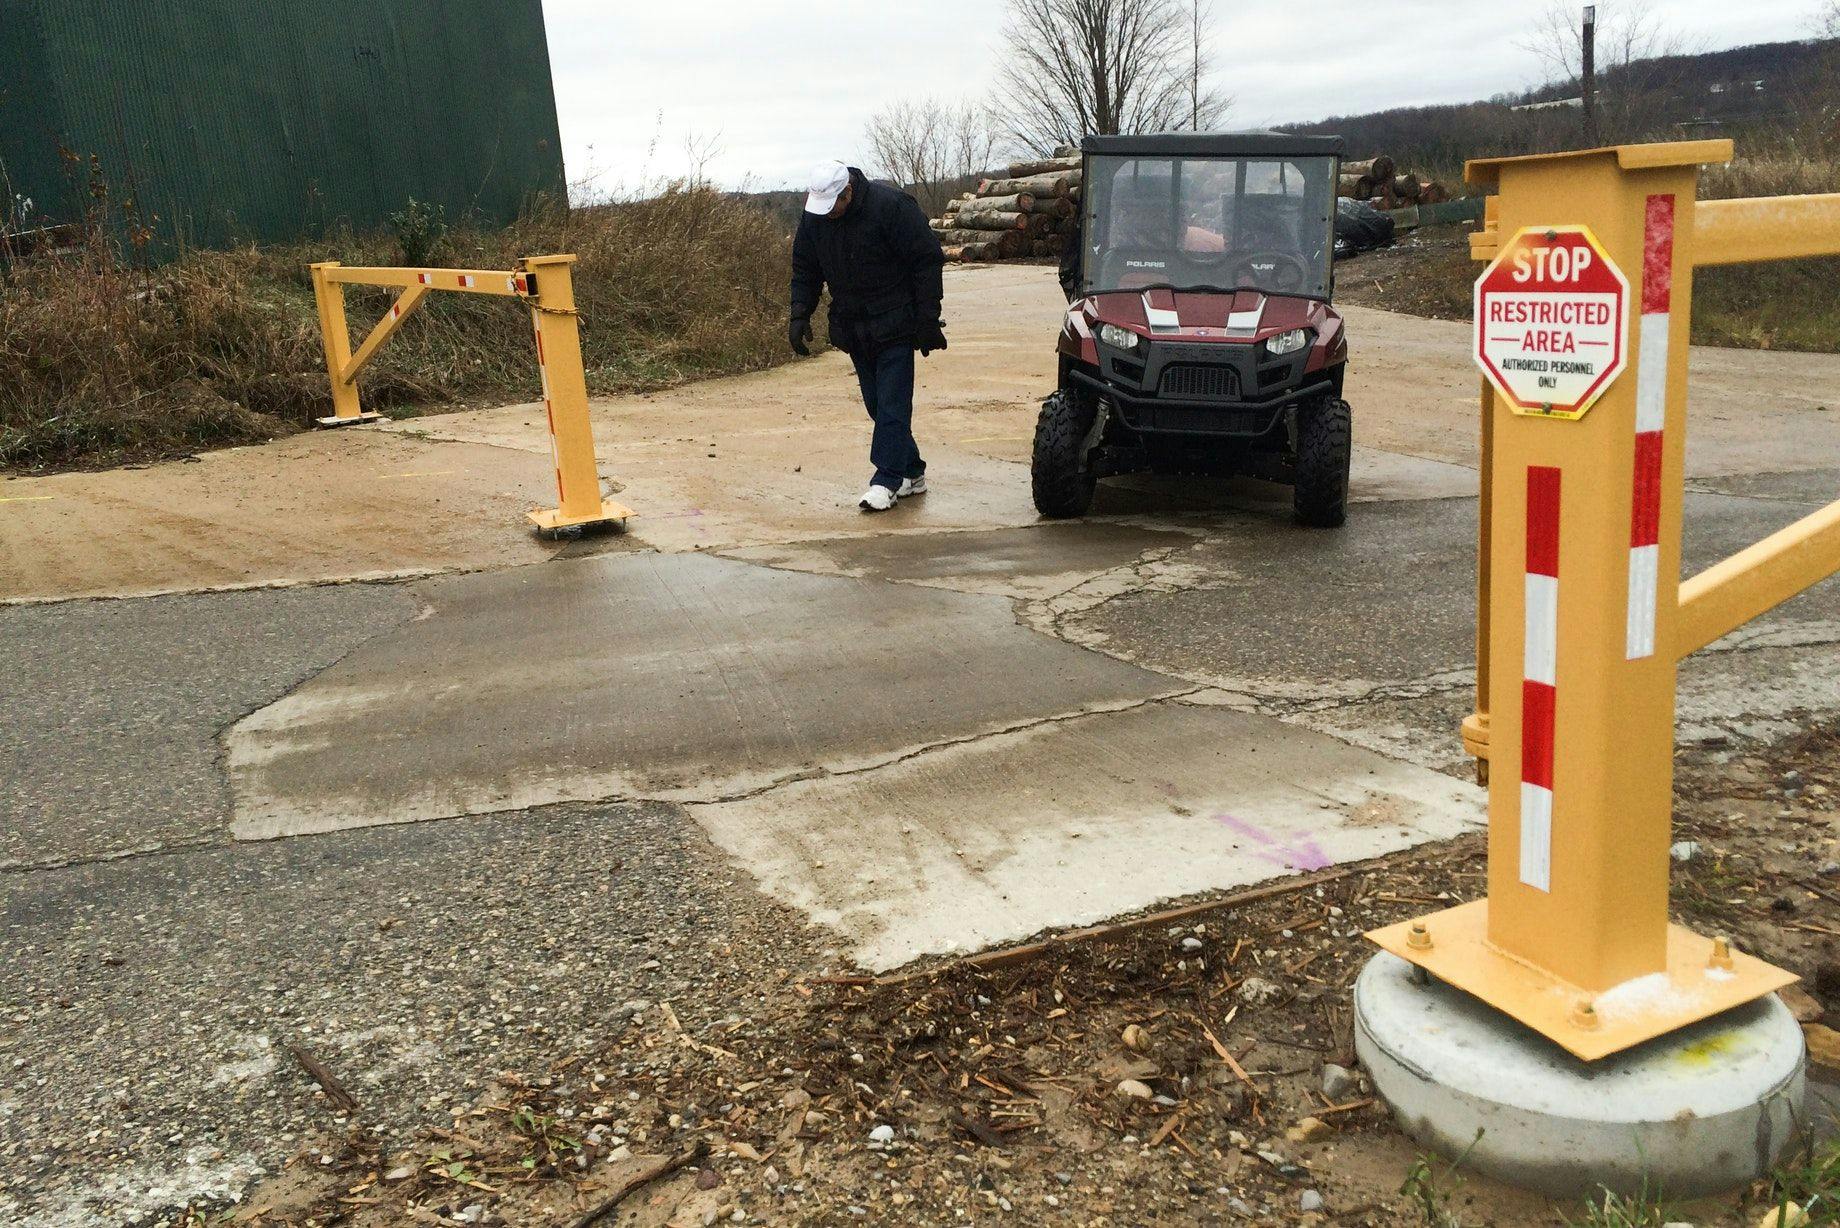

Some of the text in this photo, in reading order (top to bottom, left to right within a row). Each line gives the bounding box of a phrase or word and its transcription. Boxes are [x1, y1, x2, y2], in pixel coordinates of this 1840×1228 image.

[1126, 260, 1166, 268] POLARIS
[1511, 246, 1592, 283] STOP
[1490, 301, 1610, 325] RESTRICTED
[1522, 330, 1576, 353] AREA
[1502, 358, 1595, 376] AUTHORIZED PERSONNEL
[1538, 376, 1558, 389] ONLY
